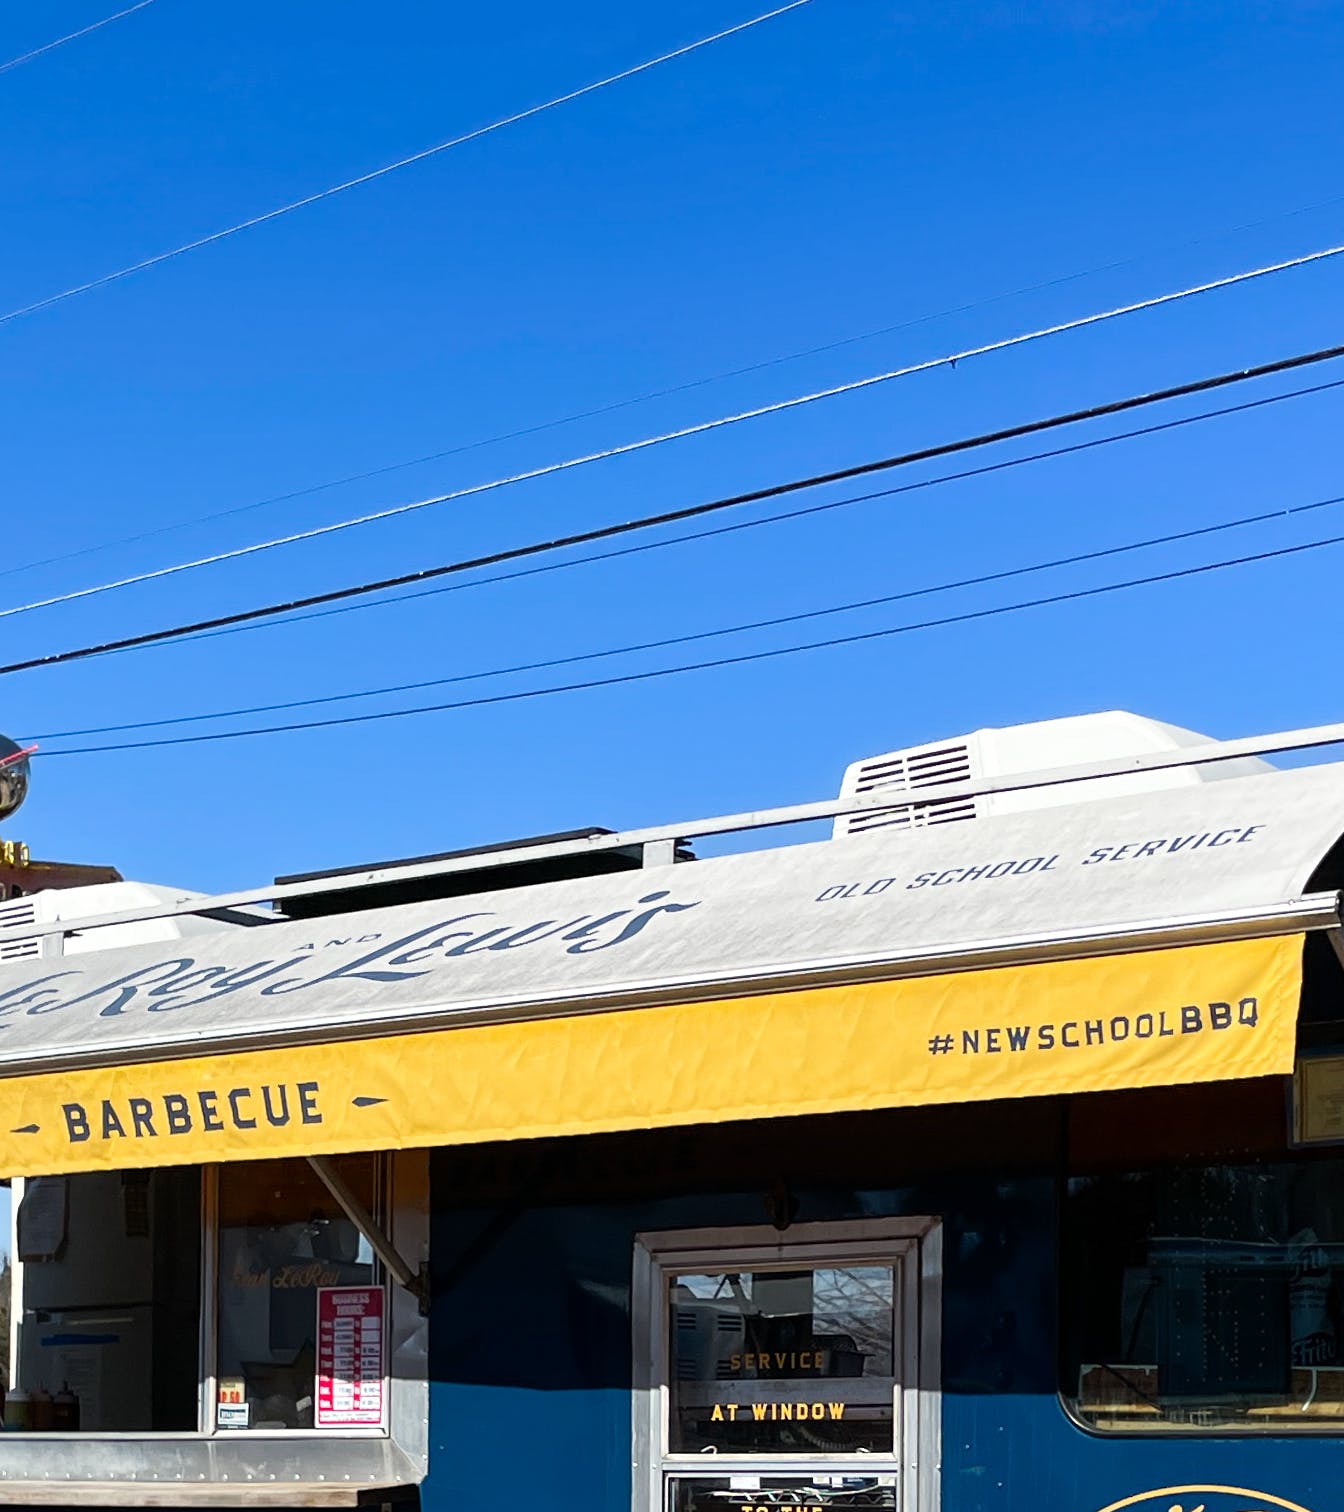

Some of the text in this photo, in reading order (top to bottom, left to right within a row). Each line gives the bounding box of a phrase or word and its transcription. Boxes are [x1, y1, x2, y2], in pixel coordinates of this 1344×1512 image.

[815, 824, 1268, 902] OLD SCHOOL SERVICE
[261, 889, 701, 997] Lewis
[296, 932, 381, 952] AND
[928, 997, 1259, 1056] #NEWSCHOOLBBQ
[61, 1081, 323, 1144] BARBECUE
[729, 1350, 824, 1372] SERVICE
[710, 1402, 846, 1421] AT WINDOW
